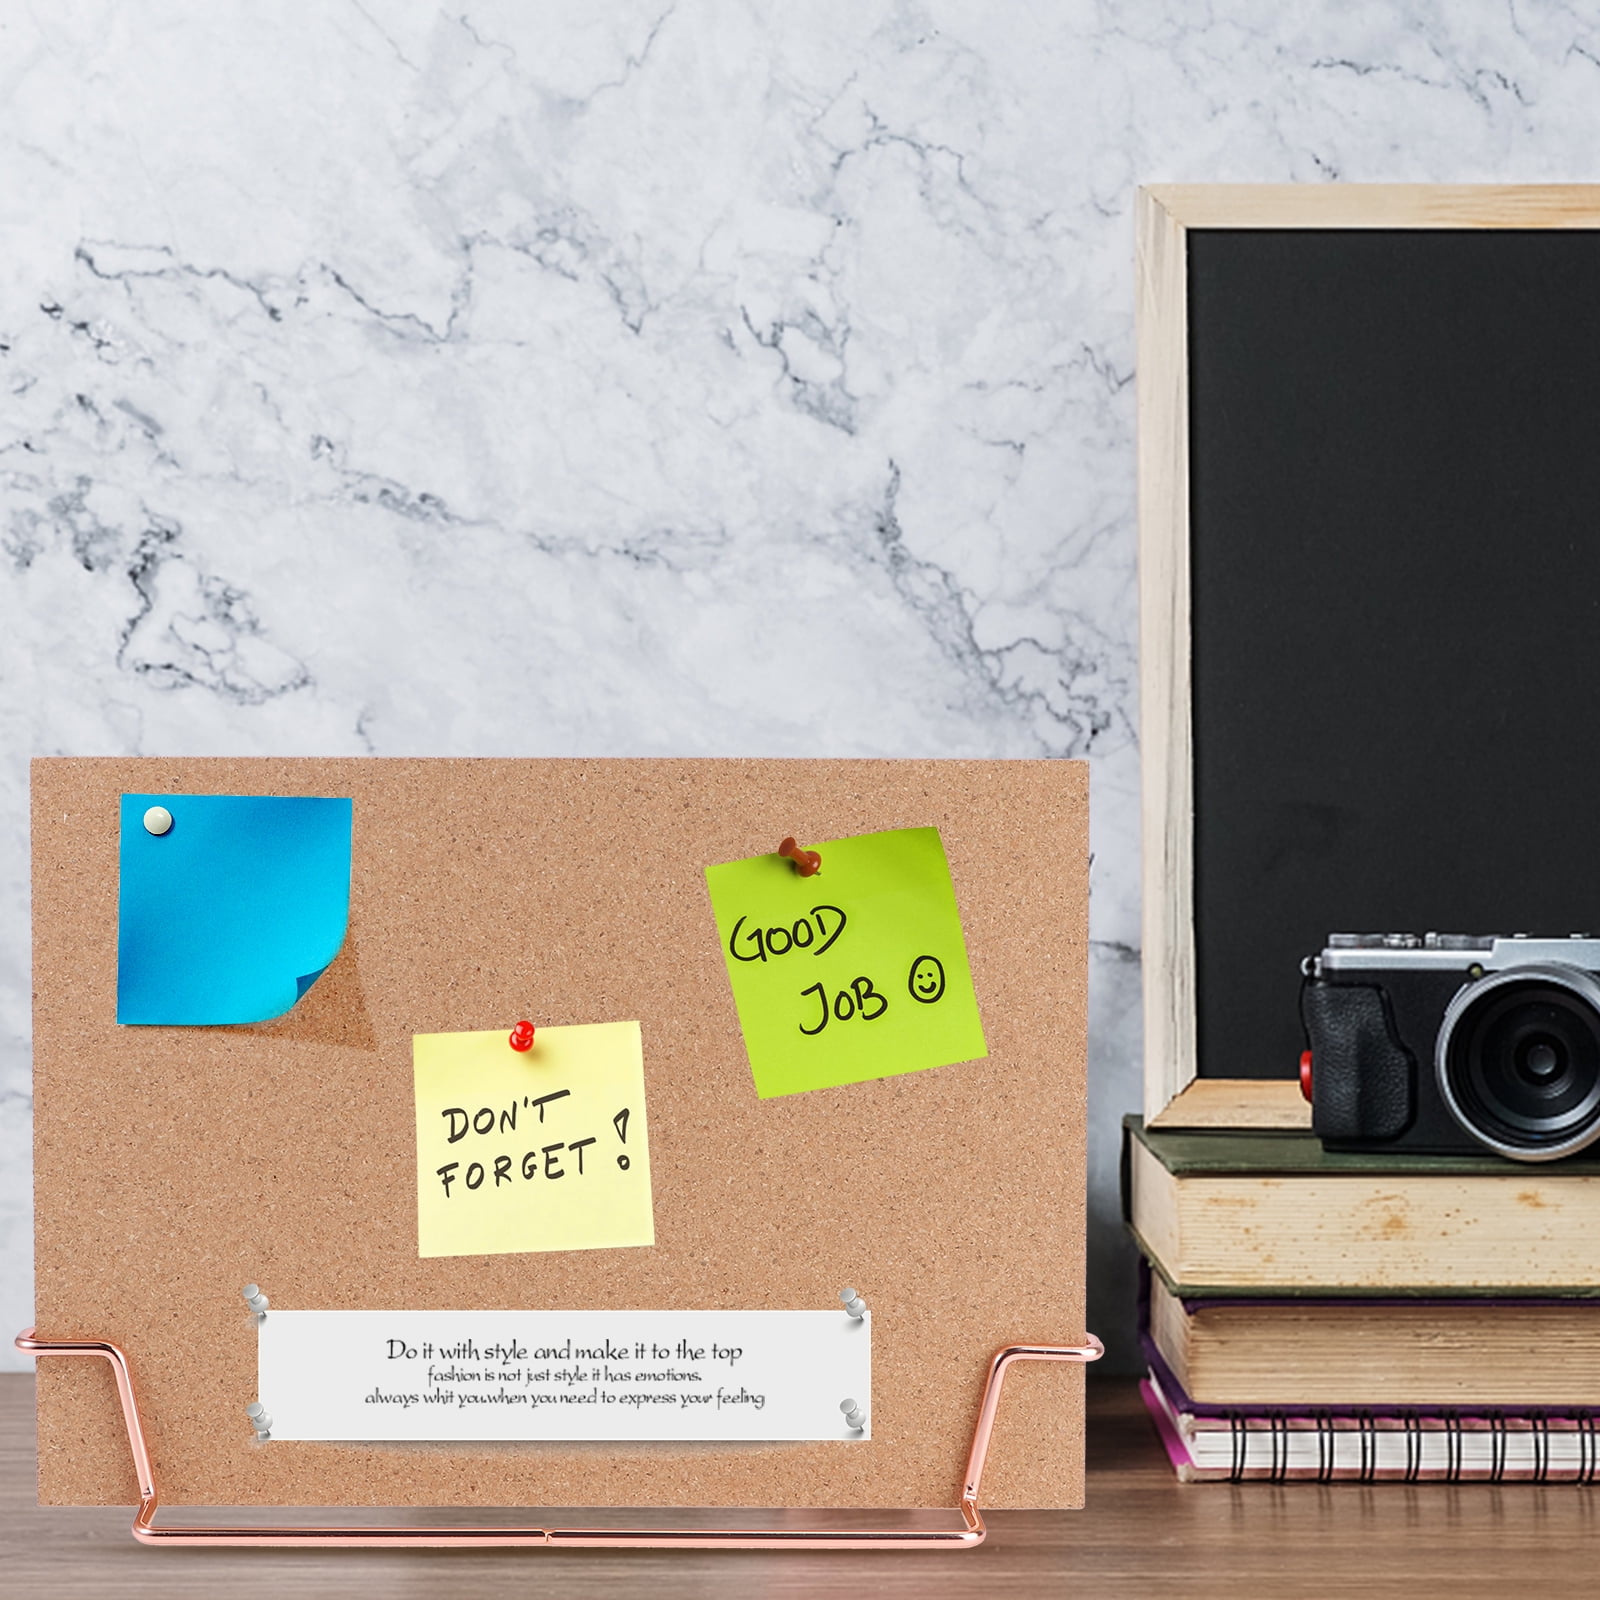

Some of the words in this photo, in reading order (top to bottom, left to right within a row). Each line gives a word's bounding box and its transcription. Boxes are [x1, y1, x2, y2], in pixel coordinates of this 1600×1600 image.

[729, 905, 847, 962] GOOD
[799, 976, 888, 1035] JOB
[441, 1089, 571, 1144] DON'T
[436, 1137, 597, 1198] FORGET
[386, 1339, 418, 1359] Do
[422, 1343, 435, 1359] it
[439, 1339, 481, 1360] with
[483, 1339, 529, 1365] style
[533, 1339, 571, 1359] and
[575, 1339, 630, 1360] make
[635, 1343, 647, 1359] it
[651, 1344, 671, 1359] to
[675, 1339, 706, 1360] the
[711, 1344, 743, 1366] top
[427, 1365, 481, 1386] fashion
[484, 1368, 496, 1381] is
[498, 1369, 522, 1381] not
[525, 1368, 551, 1387] just
[553, 1365, 588, 1386] style
[592, 1368, 601, 1380] it
[604, 1365, 632, 1382] has
[634, 1368, 703, 1381] emotions.
[364, 1387, 420, 1408] always
[422, 1387, 455, 1404] whit
[530, 1395, 558, 1408] you
[559, 1387, 598, 1403] need
[600, 1391, 617, 1403] to
[618, 1394, 677, 1408] express
[680, 1395, 713, 1408] your
[716, 1387, 766, 1409] feeling
